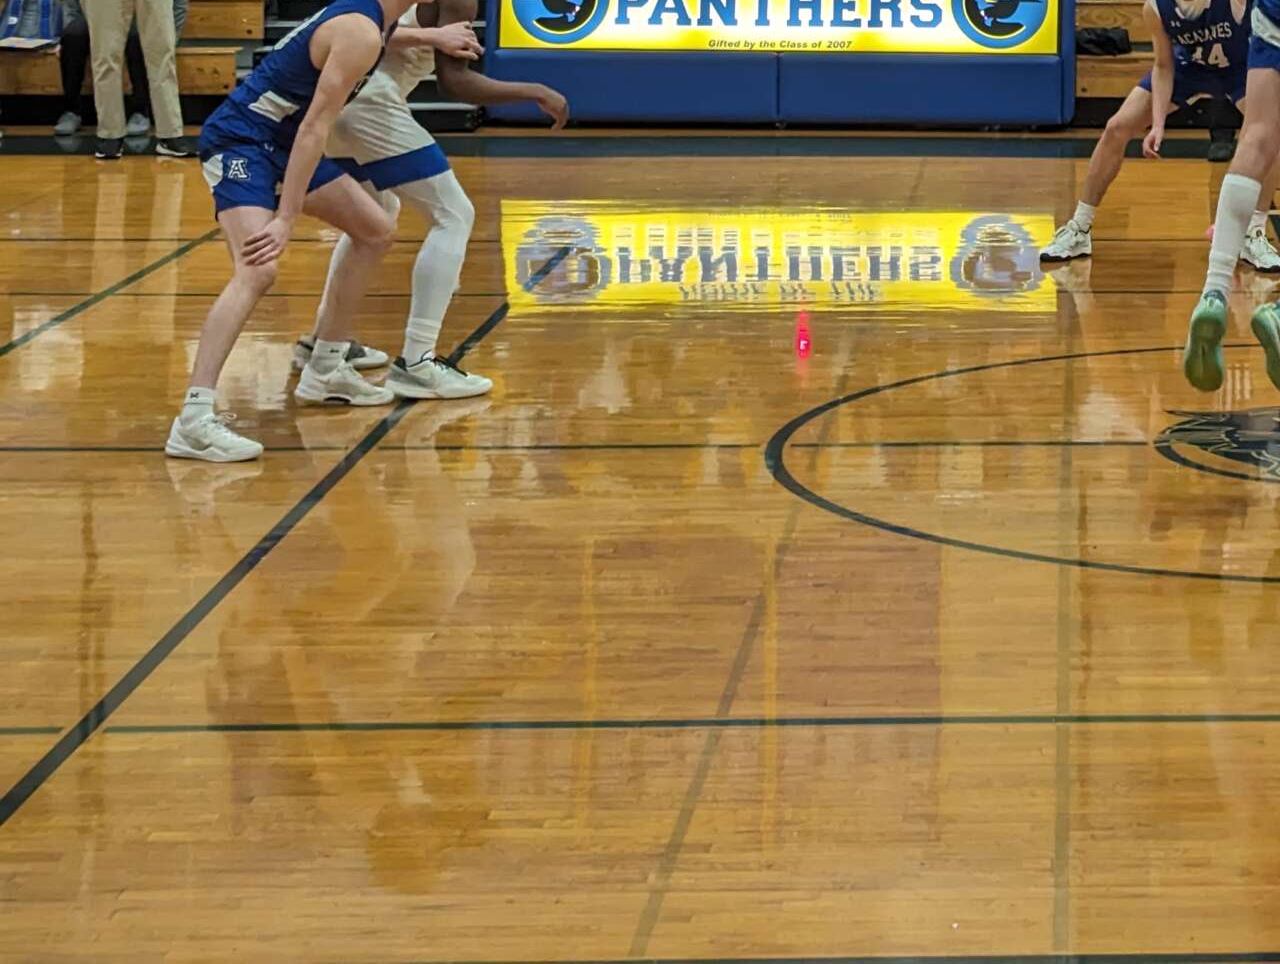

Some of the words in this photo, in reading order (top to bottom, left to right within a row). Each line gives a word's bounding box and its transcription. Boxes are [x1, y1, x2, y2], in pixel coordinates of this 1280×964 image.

[708, 39, 741, 48] Gifted
[744, 39, 756, 50] by
[760, 39, 776, 48] the
[780, 40, 808, 49] Class
[811, 40, 822, 49] of
[827, 40, 853, 49] 2007
[227, 158, 249, 180] A
